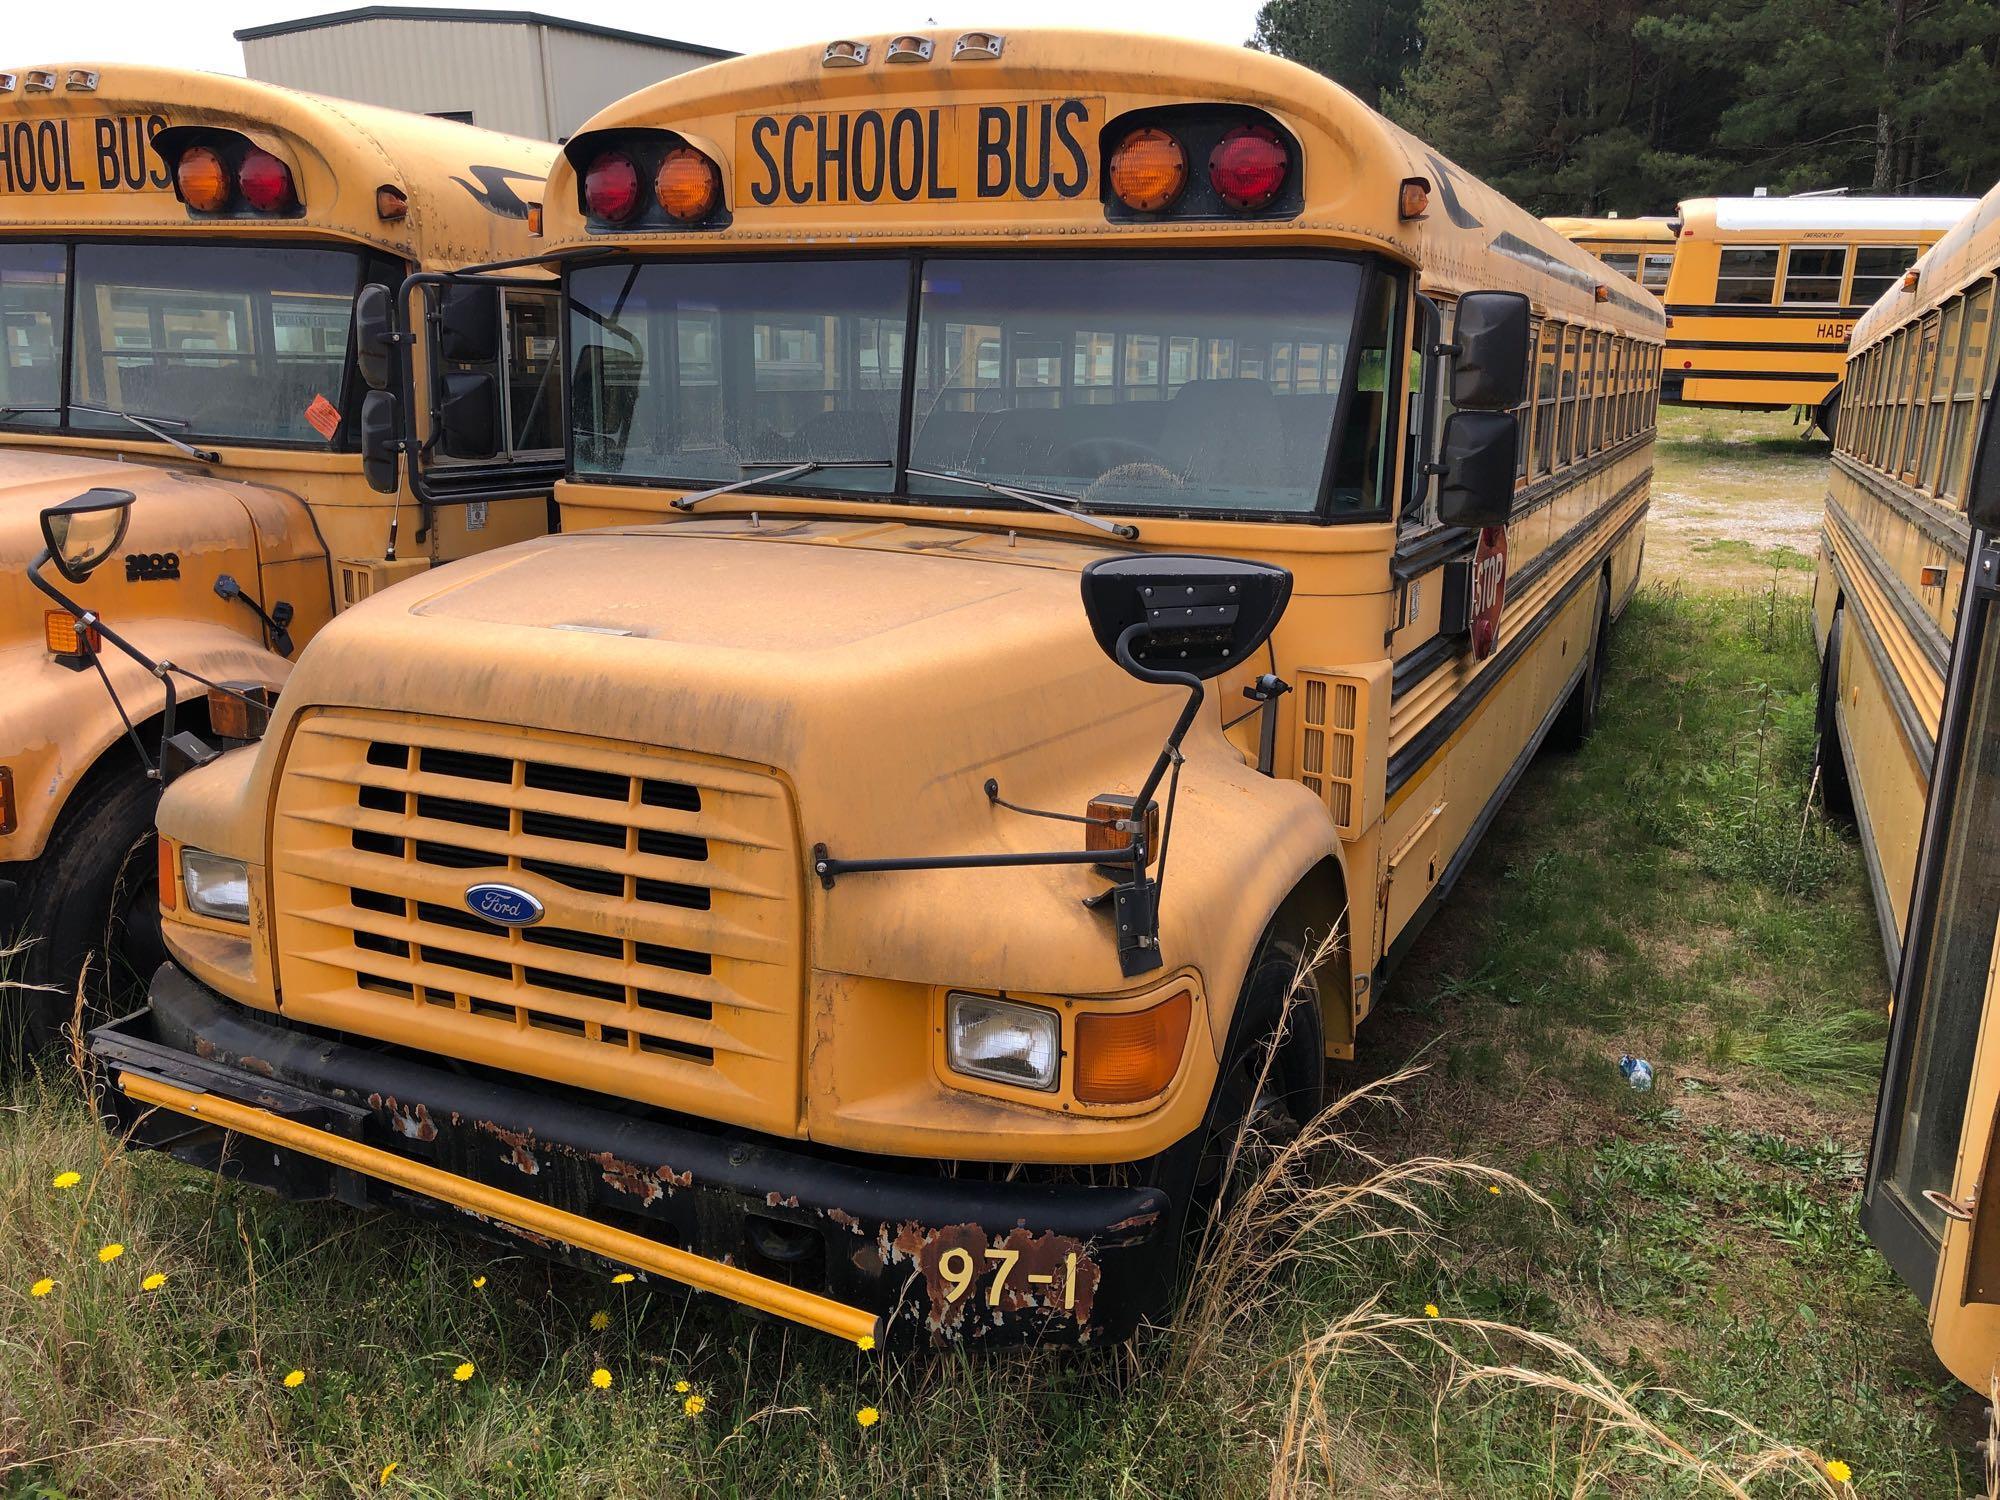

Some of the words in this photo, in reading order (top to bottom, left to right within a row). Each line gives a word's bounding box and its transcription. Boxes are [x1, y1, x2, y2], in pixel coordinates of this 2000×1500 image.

[95, 114, 174, 191] BUS
[751, 108, 957, 205] SCHOOL
[977, 100, 1089, 199] BUS
[1475, 553, 1503, 617] STOP
[481, 891, 521, 917] Ford
[938, 1247, 1077, 1310] 97-1
